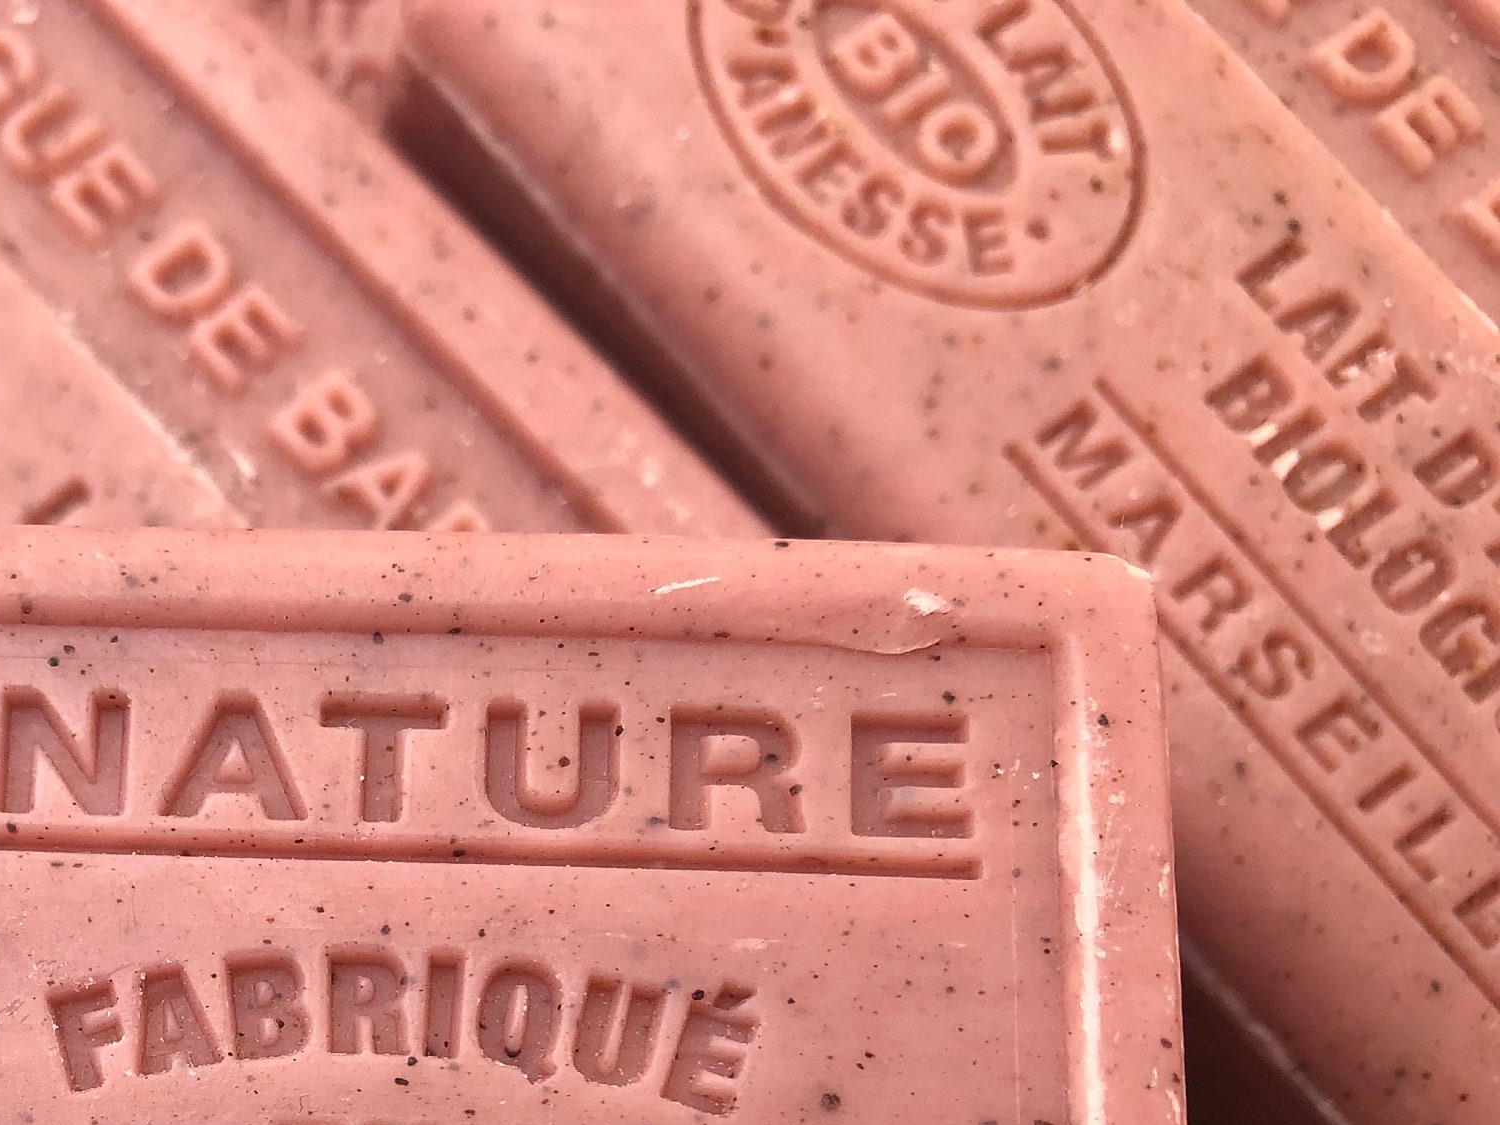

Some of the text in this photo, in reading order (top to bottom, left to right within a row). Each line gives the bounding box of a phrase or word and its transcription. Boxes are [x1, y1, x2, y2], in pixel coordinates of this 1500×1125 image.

[833, 13, 998, 187] BIO
[1305, 5, 1487, 182] DE
[128, 218, 308, 398] DE
[265, 368, 490, 530] BA
[1205, 352, 1500, 735] BIOLOGI
[43, 946, 764, 1116] FABRIQUÉ
